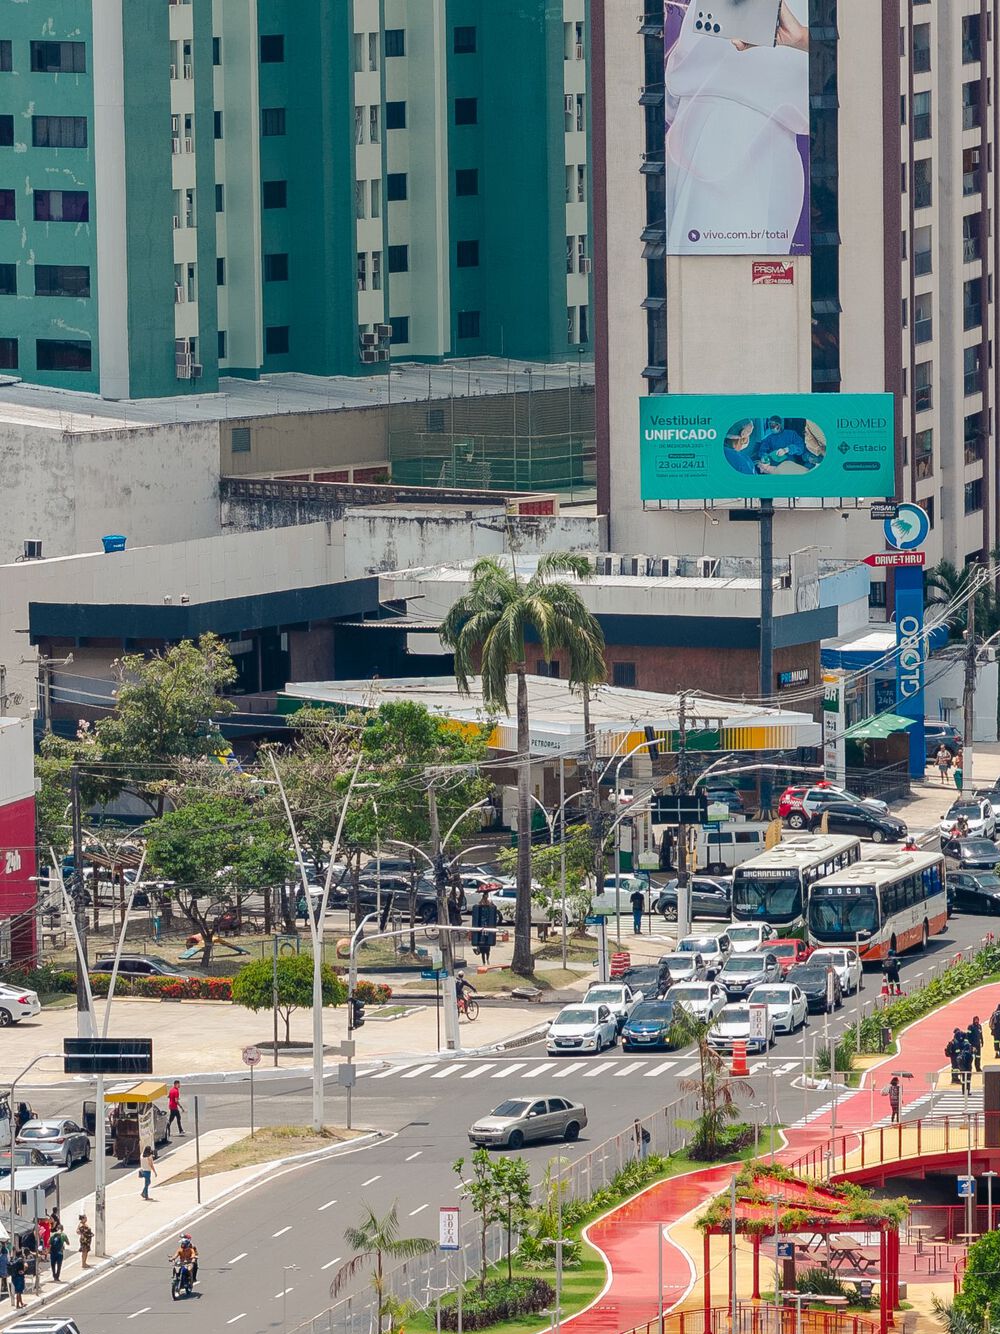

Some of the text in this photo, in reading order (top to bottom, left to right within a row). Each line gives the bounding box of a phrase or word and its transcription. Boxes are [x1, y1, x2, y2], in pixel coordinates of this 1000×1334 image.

[703, 229, 789, 240] vivo.com.br/total
[754, 265, 785, 274] PRISMA
[650, 415, 712, 426] Vestibular
[836, 418, 887, 429] IDOMED
[645, 429, 717, 441] UNIFICADO
[658, 461, 670, 469] 23
[682, 461, 705, 469] 24/11
[874, 554, 922, 565] DRIVE-THRU
[780, 668, 809, 684] PREMIUM
[824, 686, 837, 702] BR
[827, 887, 861, 895] DOCA
